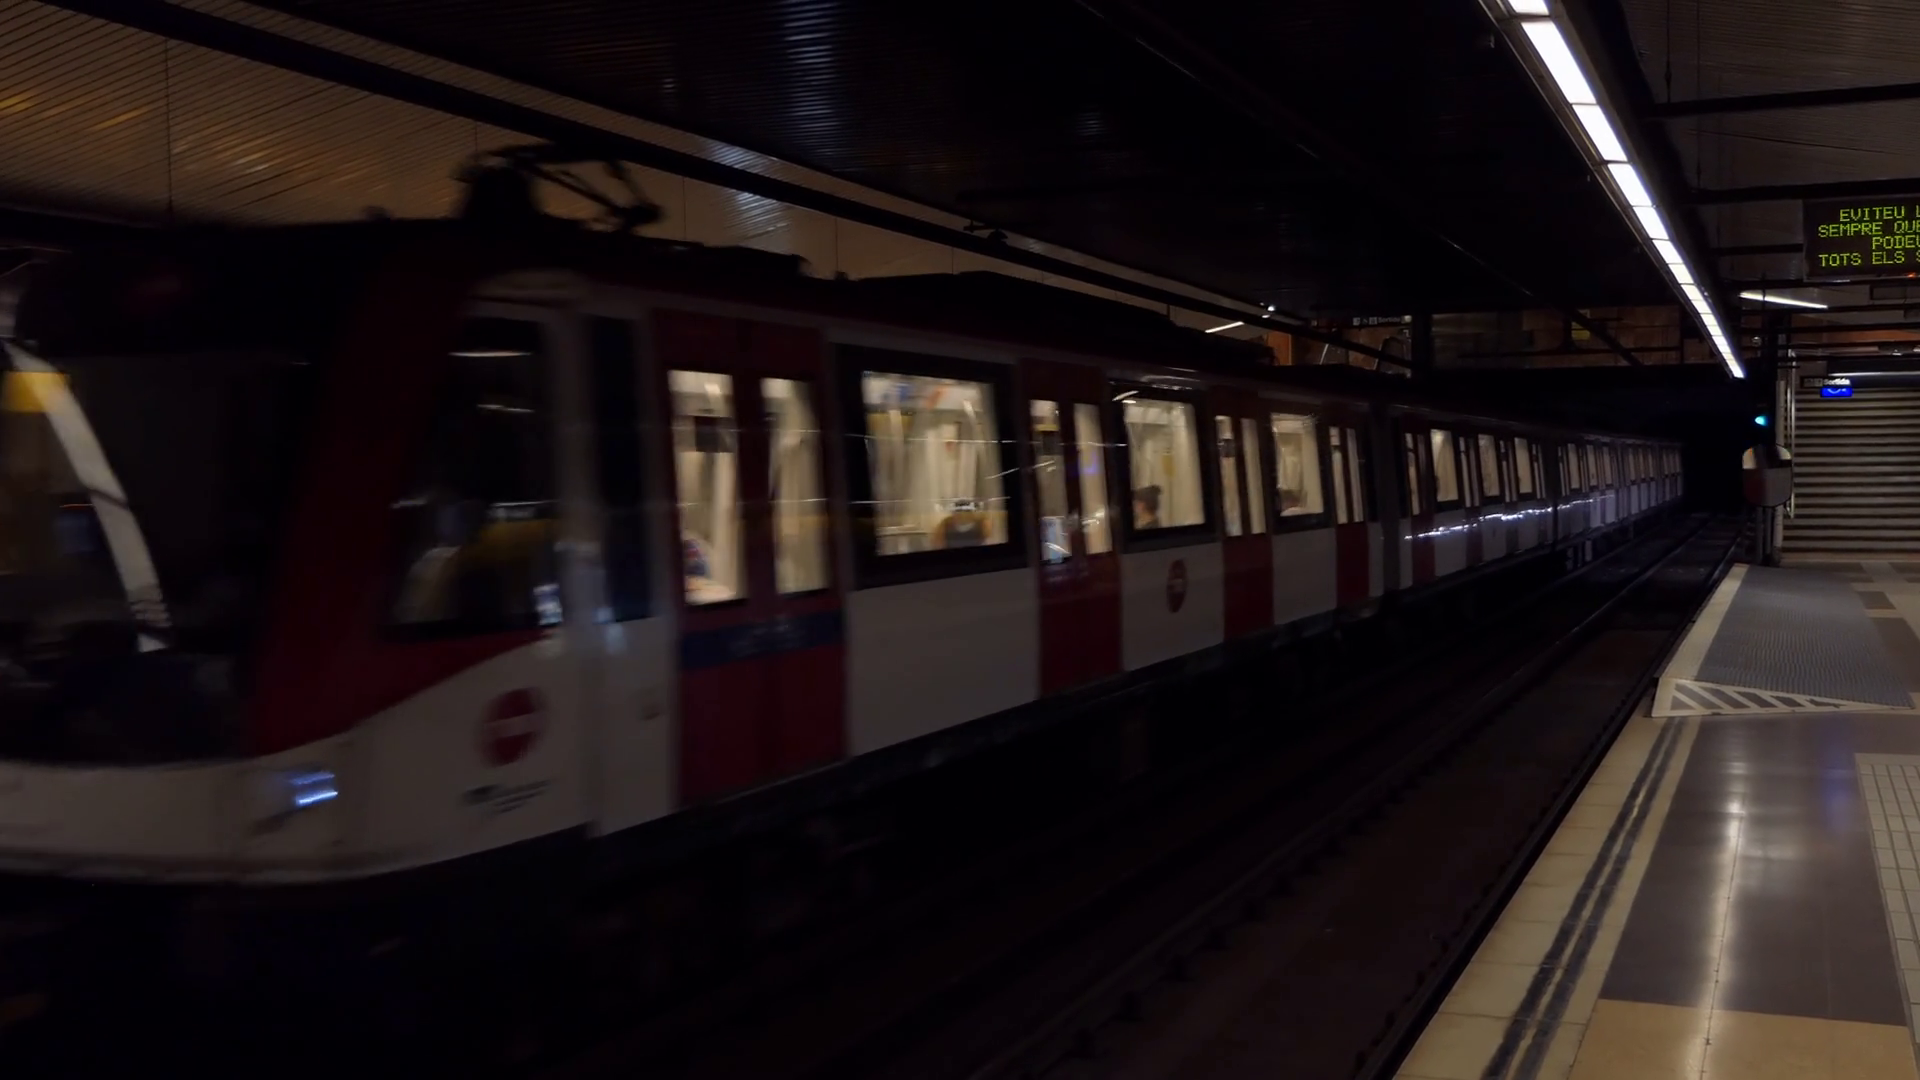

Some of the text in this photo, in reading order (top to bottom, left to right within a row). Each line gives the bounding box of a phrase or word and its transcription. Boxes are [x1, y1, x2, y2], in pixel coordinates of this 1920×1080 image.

[1840, 206, 1905, 221] EVITEU
[1818, 222, 1883, 238] SEMPRE
[1818, 253, 1861, 267] TOTS
[1872, 251, 1905, 264] ELS
